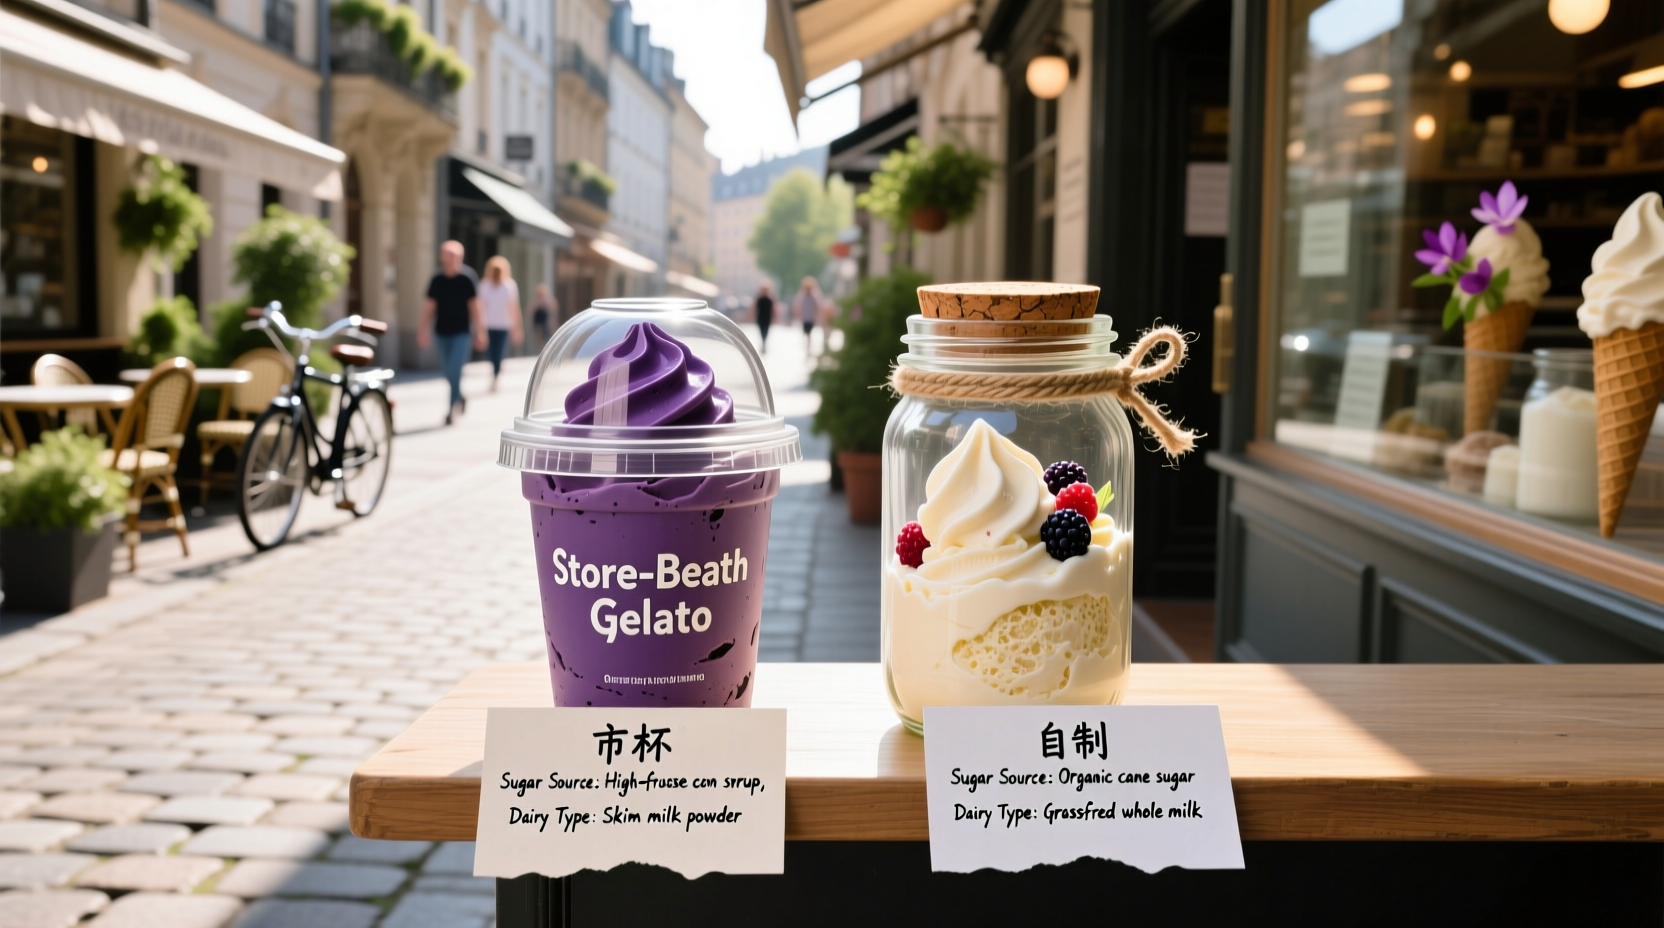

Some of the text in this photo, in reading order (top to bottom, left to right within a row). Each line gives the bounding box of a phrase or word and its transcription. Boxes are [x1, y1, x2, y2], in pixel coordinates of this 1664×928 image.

[552, 547, 749, 590] Store-Beath
[590, 597, 712, 644] Gelato
[592, 722, 672, 766] 市杯
[1040, 721, 1108, 761] 自制
[499, 771, 543, 798] Sugar
[548, 771, 600, 790] Source:
[950, 767, 1196, 794] Sugar Source: Organic cane sugar
[509, 804, 743, 833] Dairy Type: Skim milk powder
[953, 803, 993, 829] Dairy
[997, 803, 1037, 829] Type:
[1121, 800, 1164, 819] whole
[1168, 799, 1203, 819] milk
